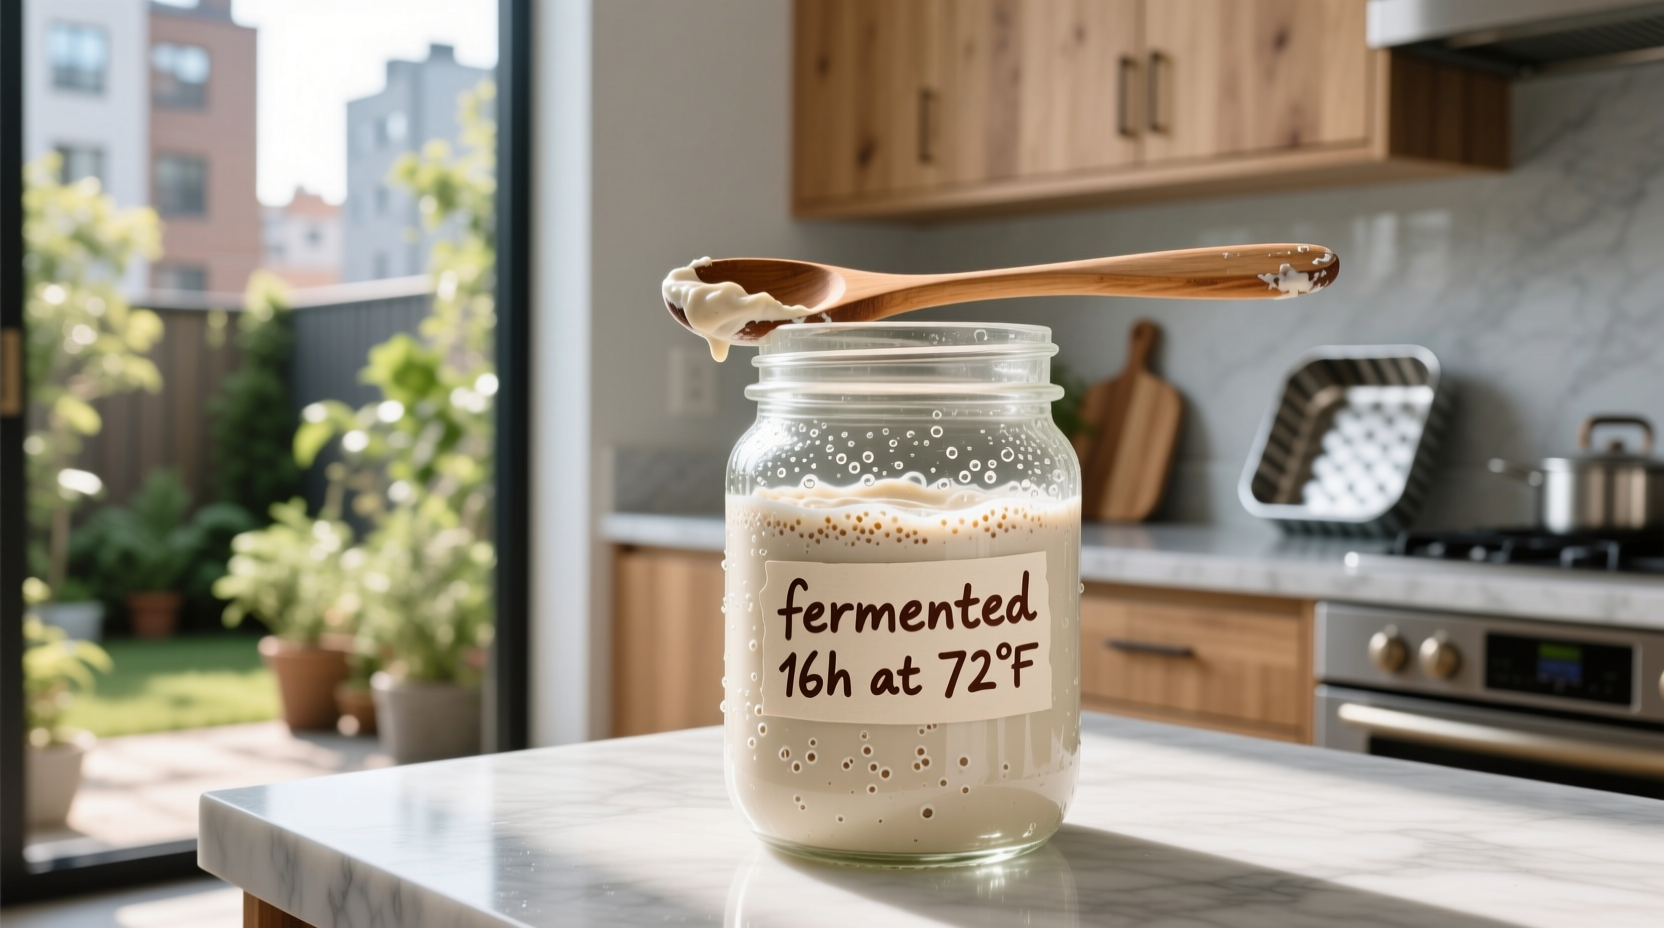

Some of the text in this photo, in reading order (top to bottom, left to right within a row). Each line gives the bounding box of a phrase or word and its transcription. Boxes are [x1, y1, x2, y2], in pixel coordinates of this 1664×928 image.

[777, 569, 1038, 641] fermented
[778, 642, 1039, 699] 16h at 72°F
